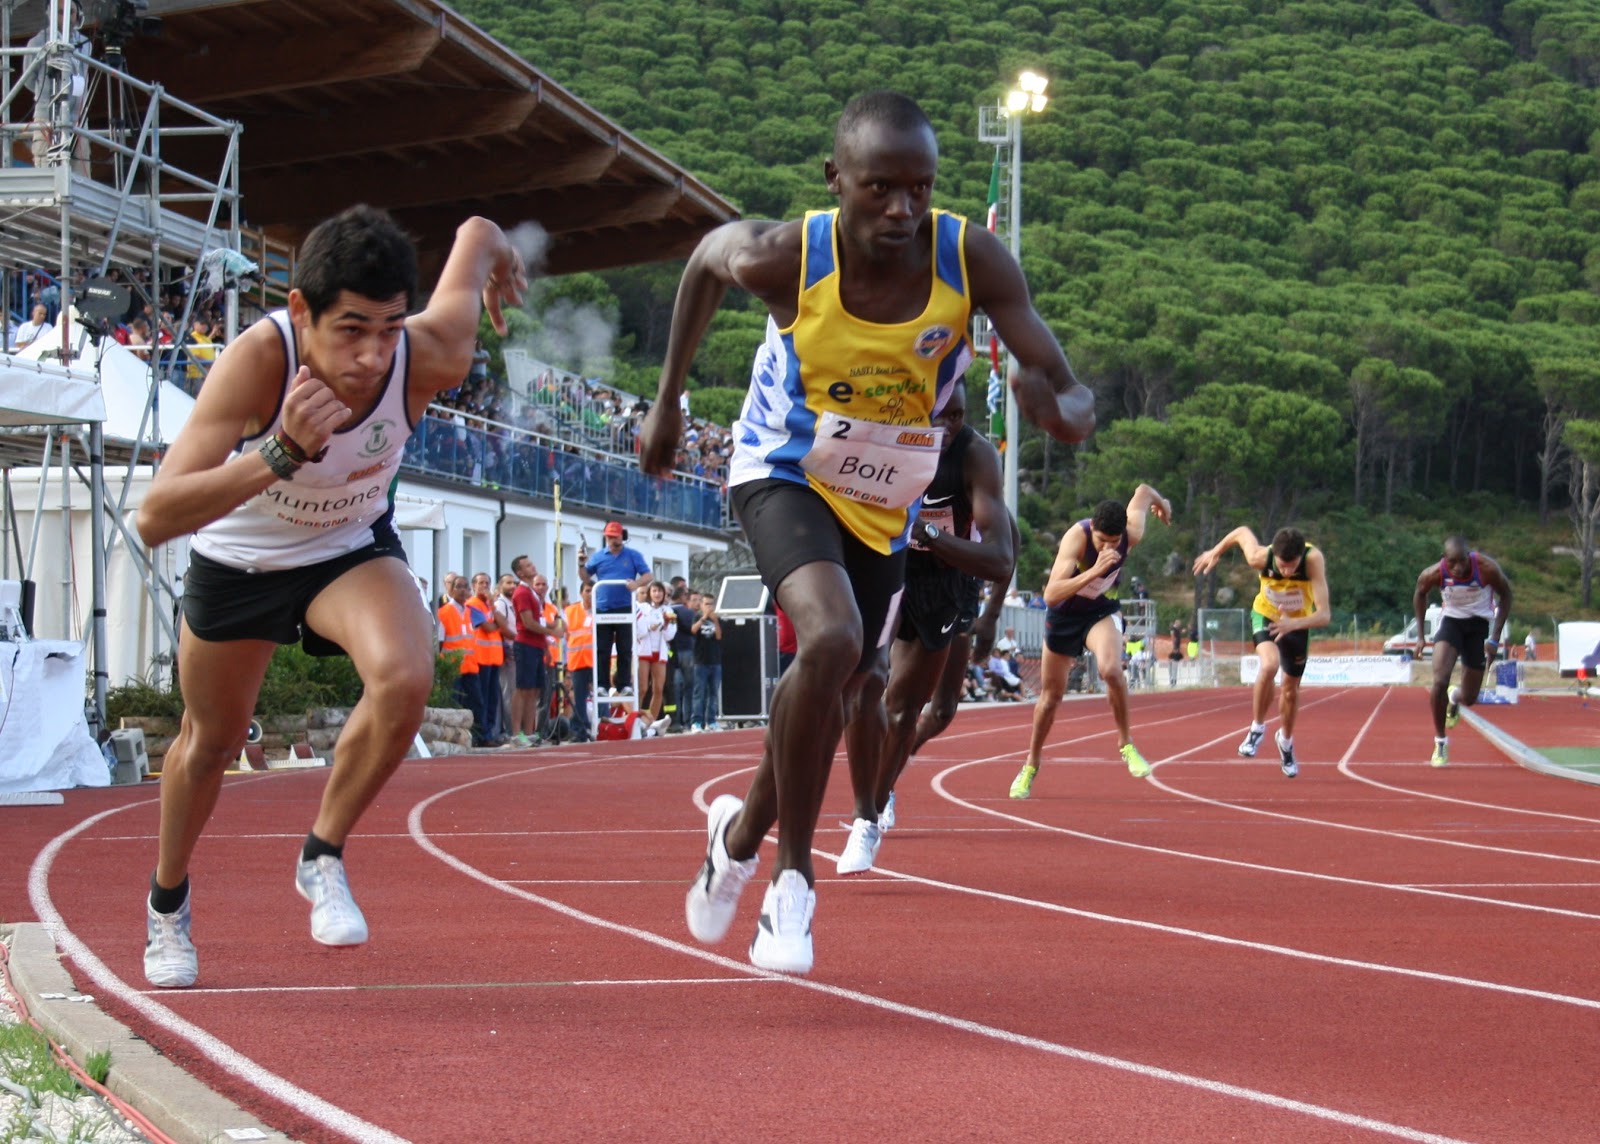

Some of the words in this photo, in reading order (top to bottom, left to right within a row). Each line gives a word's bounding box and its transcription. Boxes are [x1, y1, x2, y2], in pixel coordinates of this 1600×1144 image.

[832, 420, 852, 440] 2
[838, 456, 898, 485] Boit
[260, 485, 380, 513] Muntone
[820, 482, 888, 505] SARDEGNA
[277, 512, 349, 528] SARDEGNA
